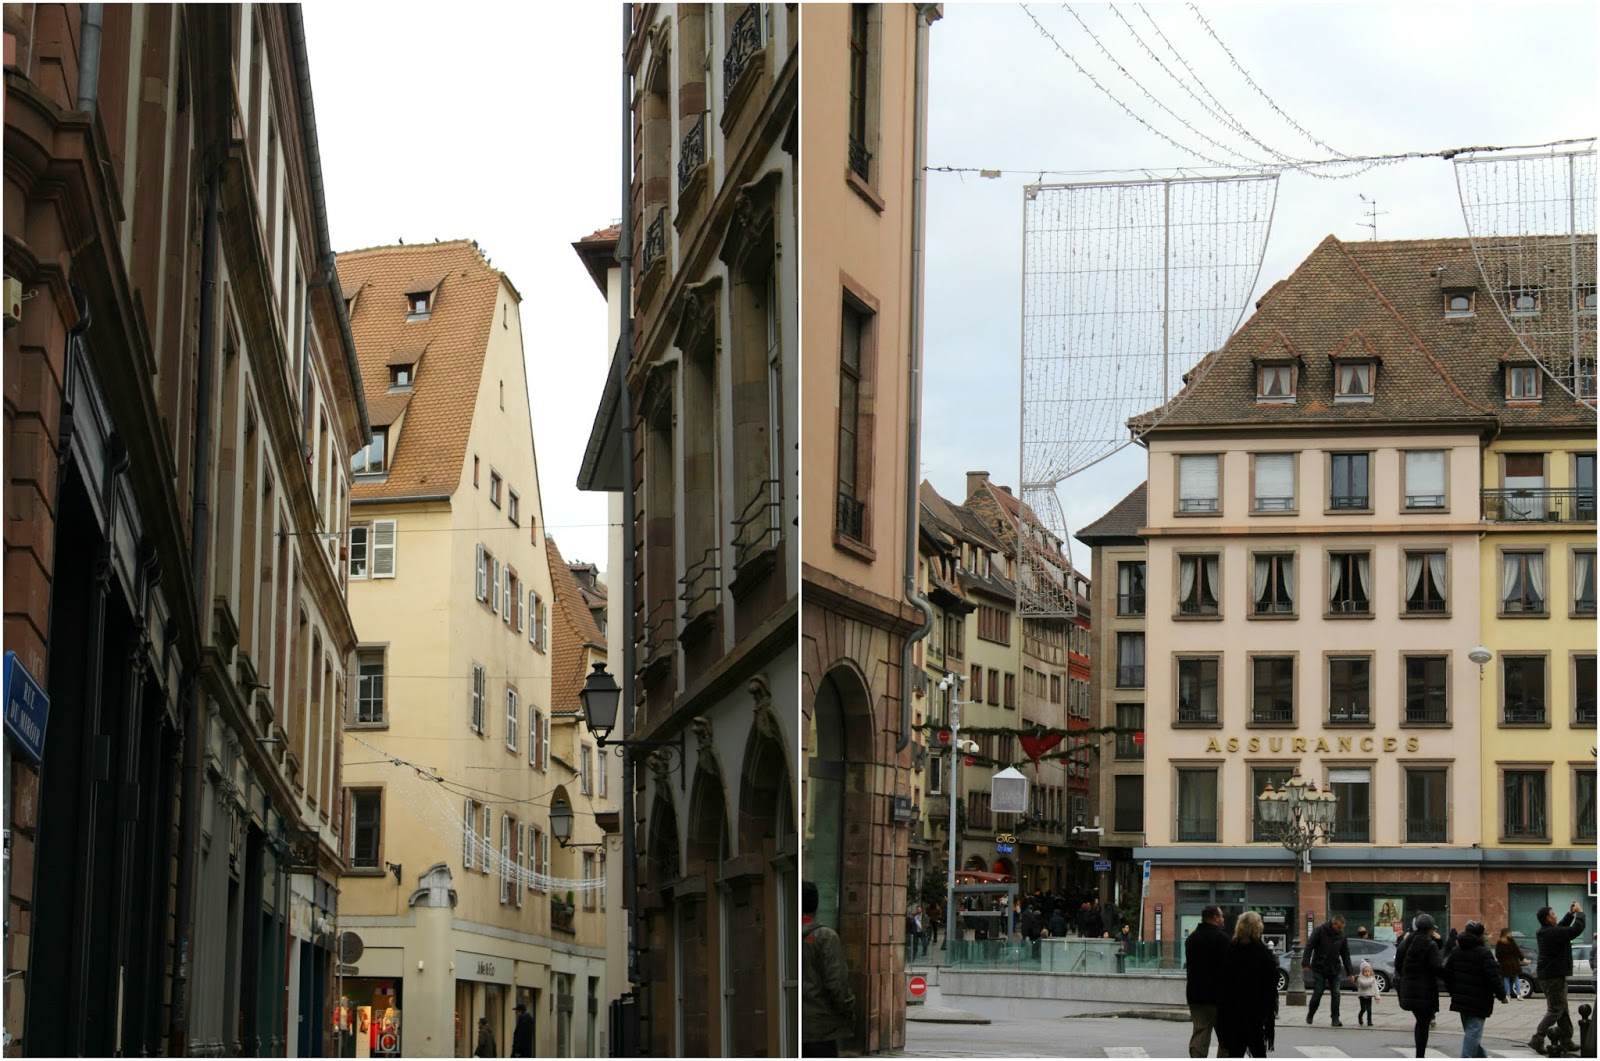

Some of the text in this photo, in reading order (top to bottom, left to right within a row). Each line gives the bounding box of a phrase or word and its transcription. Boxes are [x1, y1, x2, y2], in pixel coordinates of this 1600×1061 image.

[23, 681, 36, 710] RUE
[10, 698, 40, 747] DU MIROIR
[1206, 736, 1420, 753] ASSURANCES
